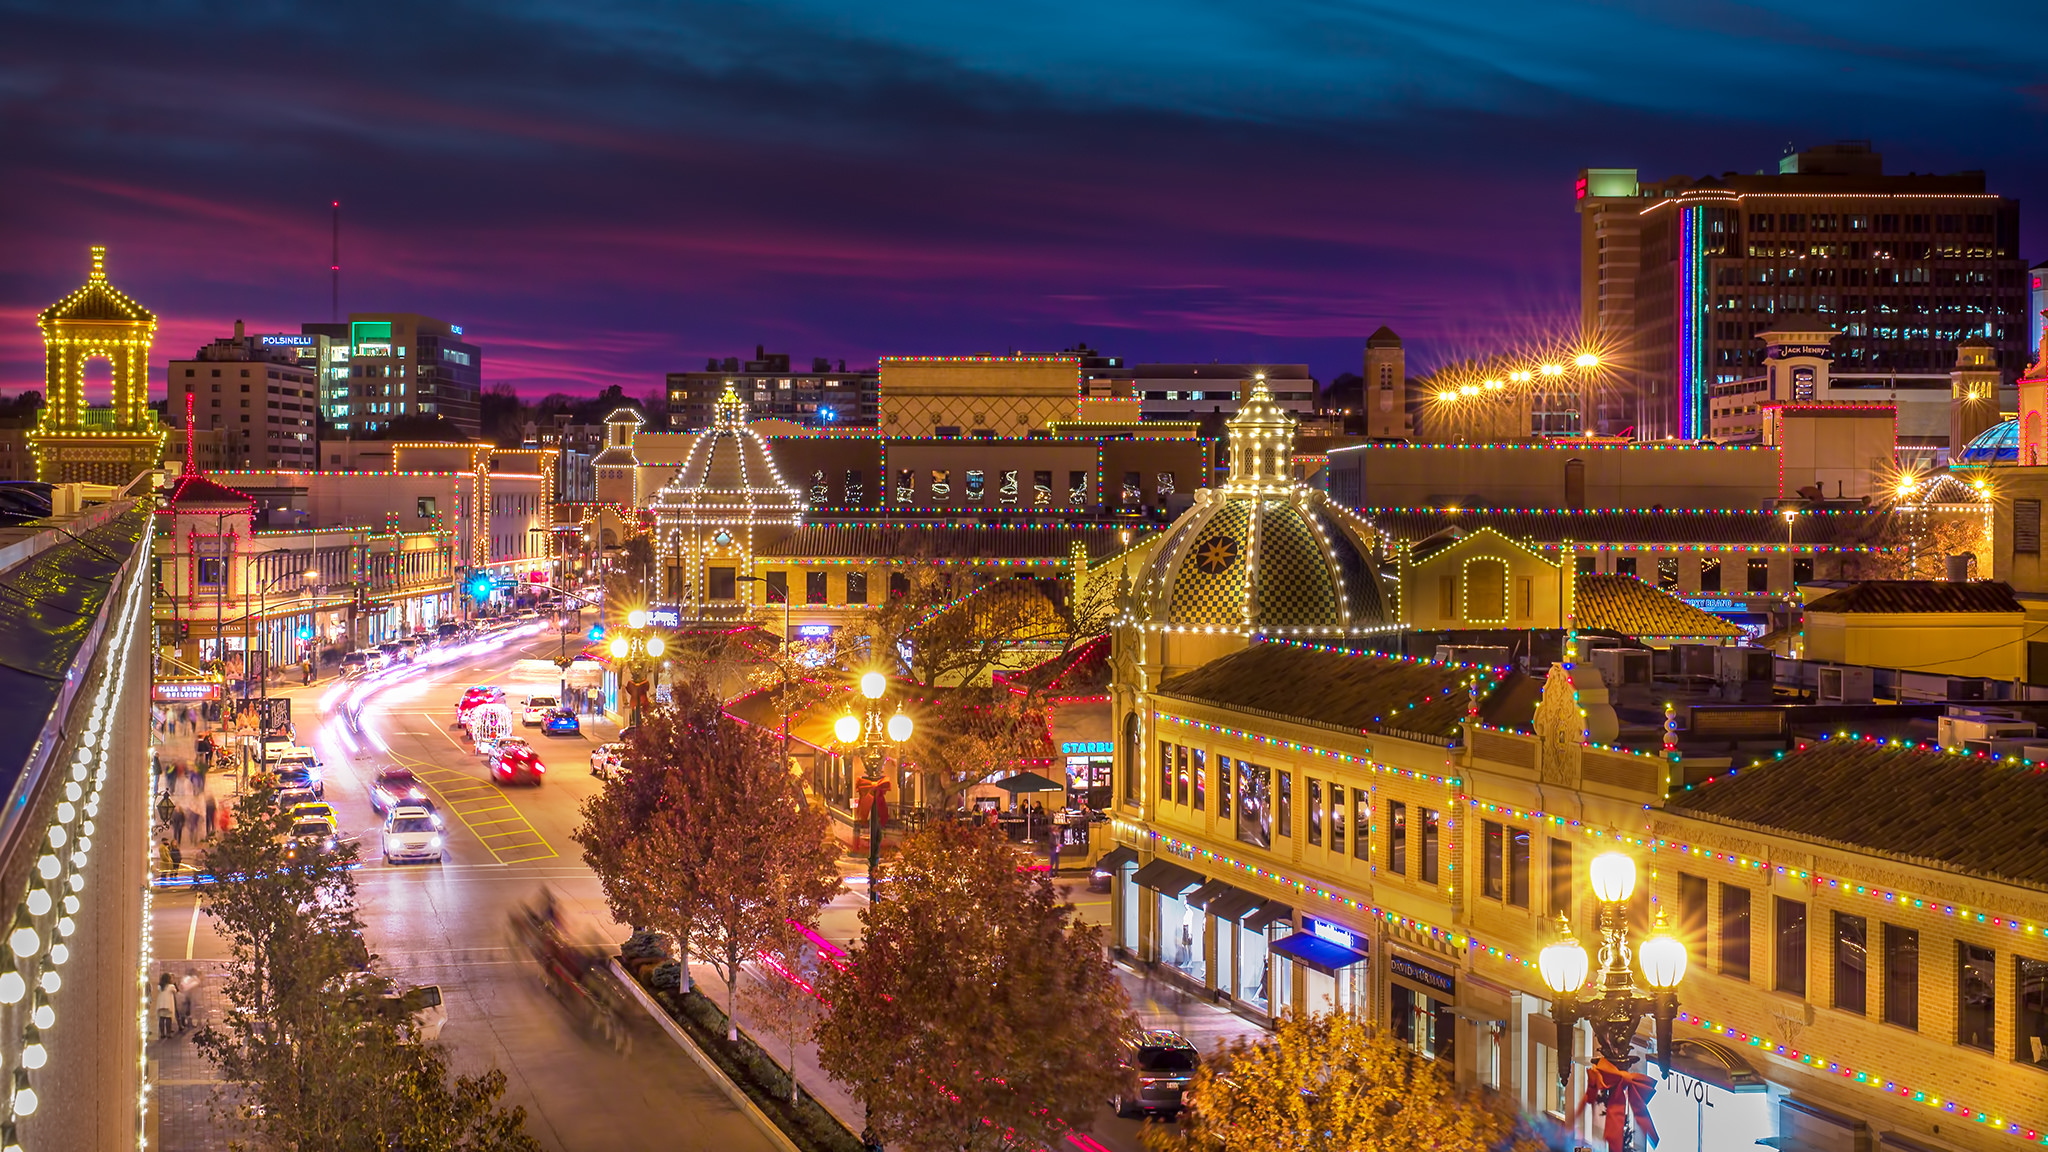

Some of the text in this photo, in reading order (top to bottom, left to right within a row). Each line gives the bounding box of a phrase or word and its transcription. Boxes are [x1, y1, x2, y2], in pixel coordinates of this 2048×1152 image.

[262, 336, 312, 345] POLSINELLI
[1705, 599, 1732, 607] BRAND
[1391, 960, 1448, 989] DAVID YURMAN
[1667, 1071, 1714, 1108] TIVOL
